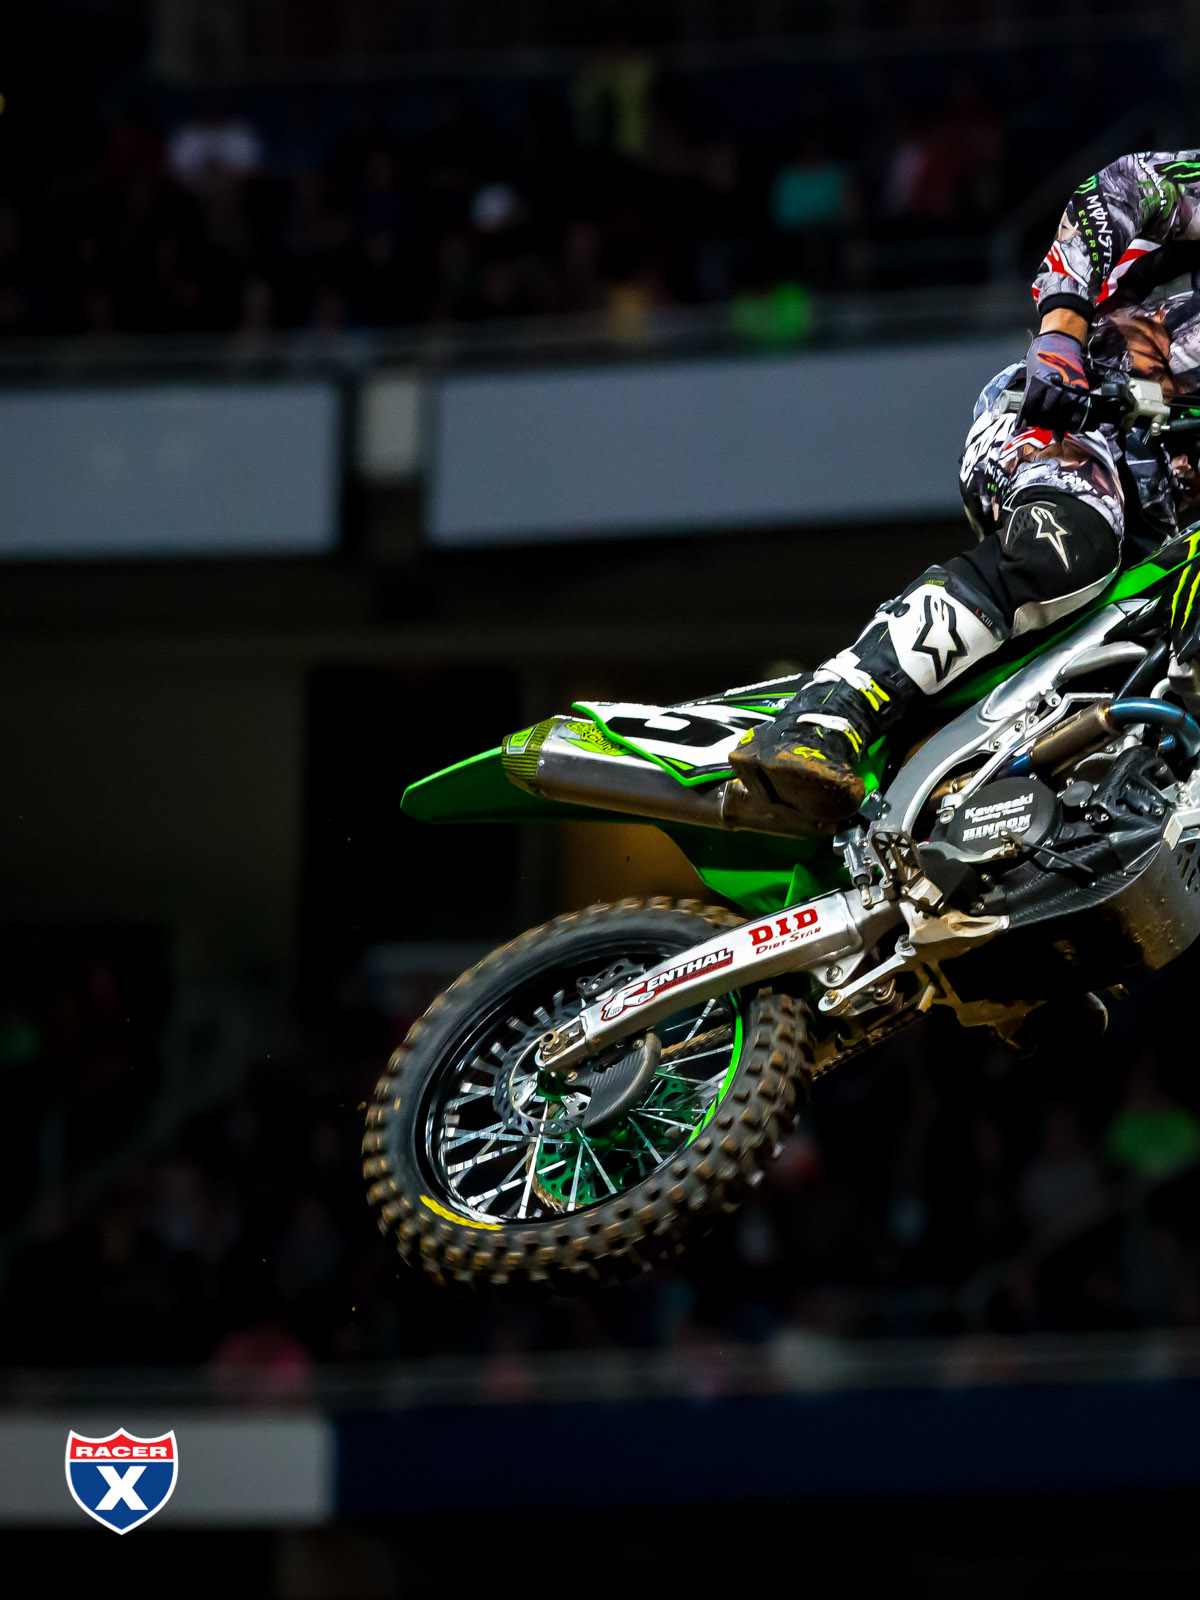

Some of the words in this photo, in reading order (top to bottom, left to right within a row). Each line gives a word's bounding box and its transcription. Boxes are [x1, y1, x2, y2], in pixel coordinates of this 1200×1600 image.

[1086, 194, 1114, 279] MONSTE
[964, 793, 1034, 820] Kawasaki
[748, 908, 819, 947] D.I.D
